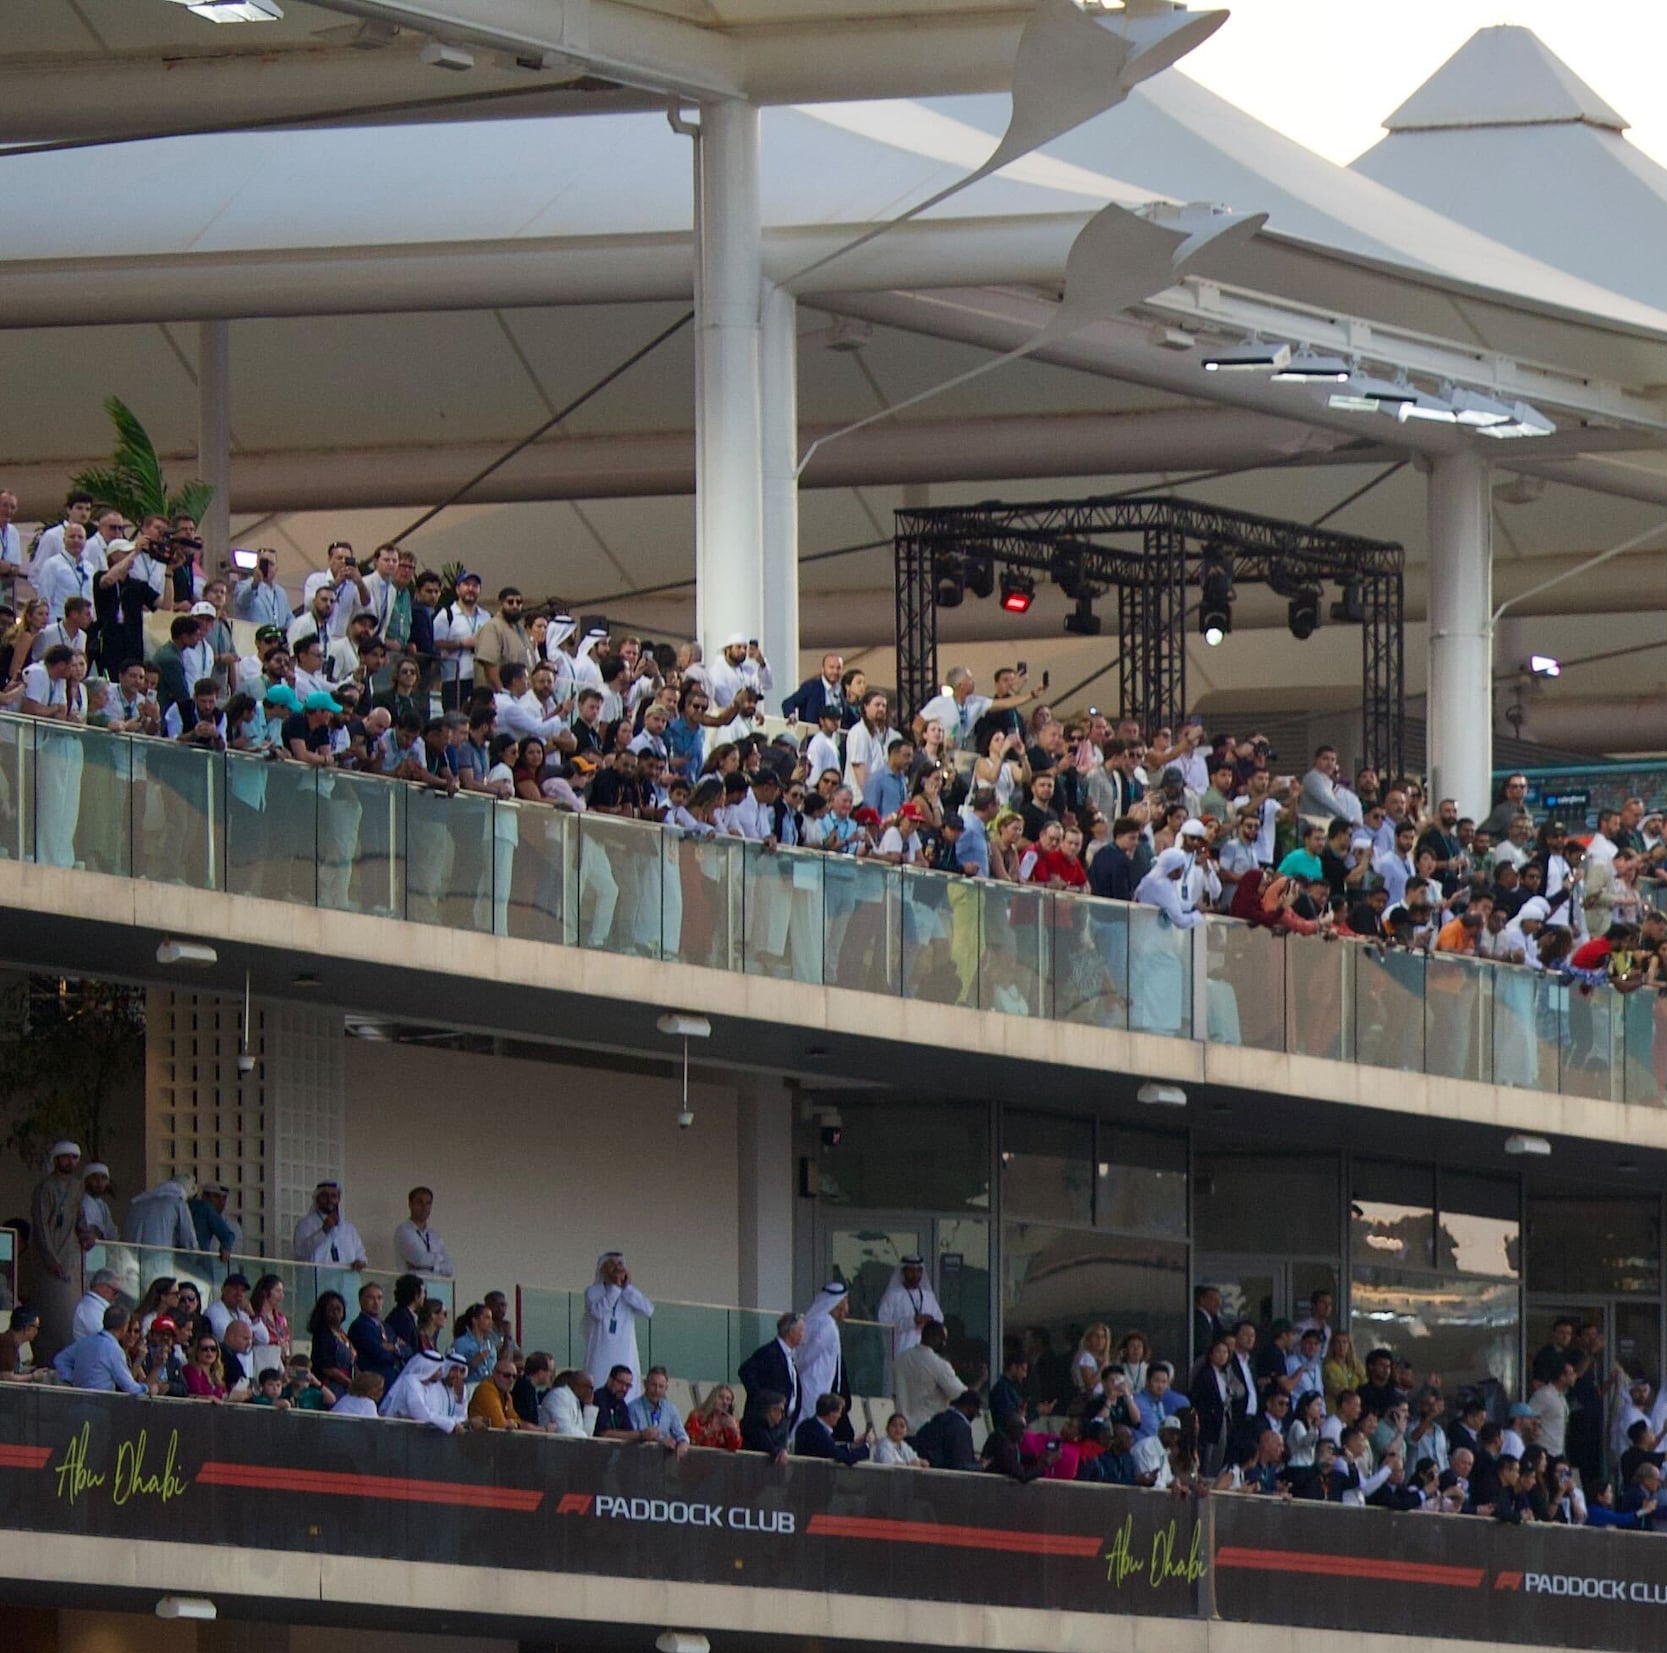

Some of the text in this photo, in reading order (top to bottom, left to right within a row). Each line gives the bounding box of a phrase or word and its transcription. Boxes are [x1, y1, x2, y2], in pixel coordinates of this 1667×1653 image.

[56, 1421, 190, 1506] Abu Dhabi
[595, 1496, 723, 1527] PADDOCK
[728, 1506, 795, 1534] CLUB
[1105, 1514, 1206, 1588] Abu Dhabi
[1525, 1573, 1626, 1600] PADDOCK
